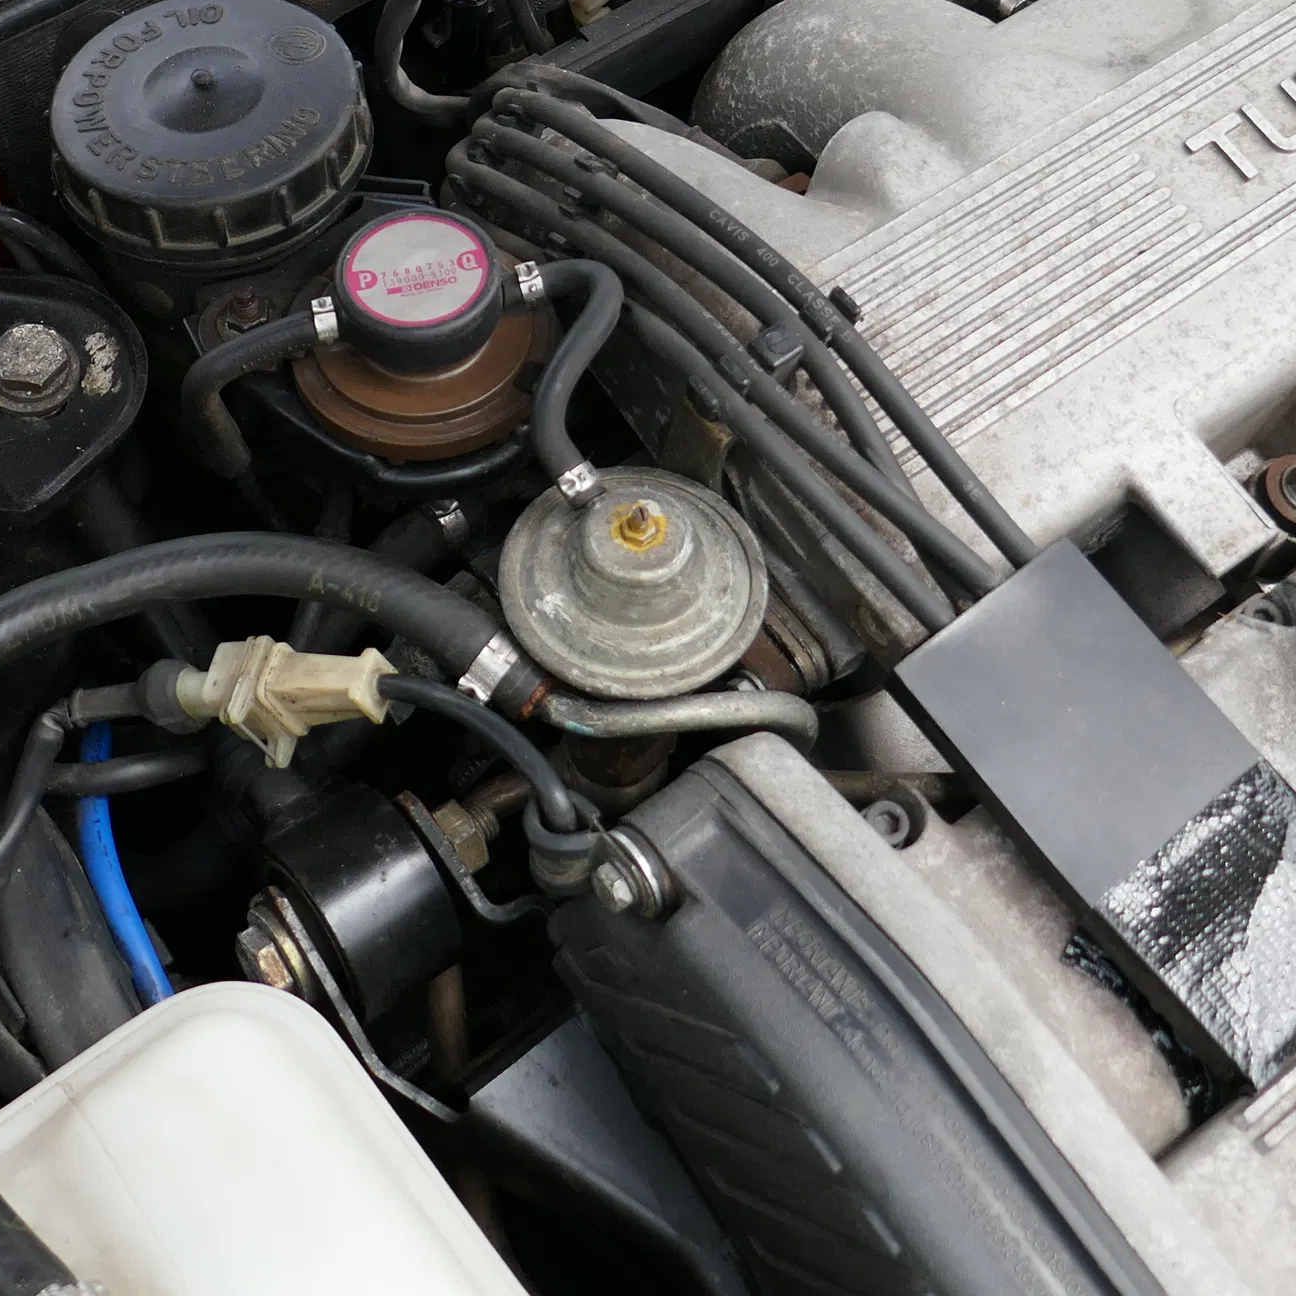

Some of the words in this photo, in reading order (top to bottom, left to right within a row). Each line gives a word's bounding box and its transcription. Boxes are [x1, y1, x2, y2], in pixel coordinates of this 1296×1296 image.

[91, 19, 163, 69] FOR
[163, 4, 224, 28] OIL
[73, 70, 138, 171] POWER
[136, 106, 321, 185] STEERING
[414, 276, 457, 291] DENSO
[709, 210, 750, 241] CAVIS
[756, 247, 780, 267] 400
[787, 274, 841, 329] CLASSE
